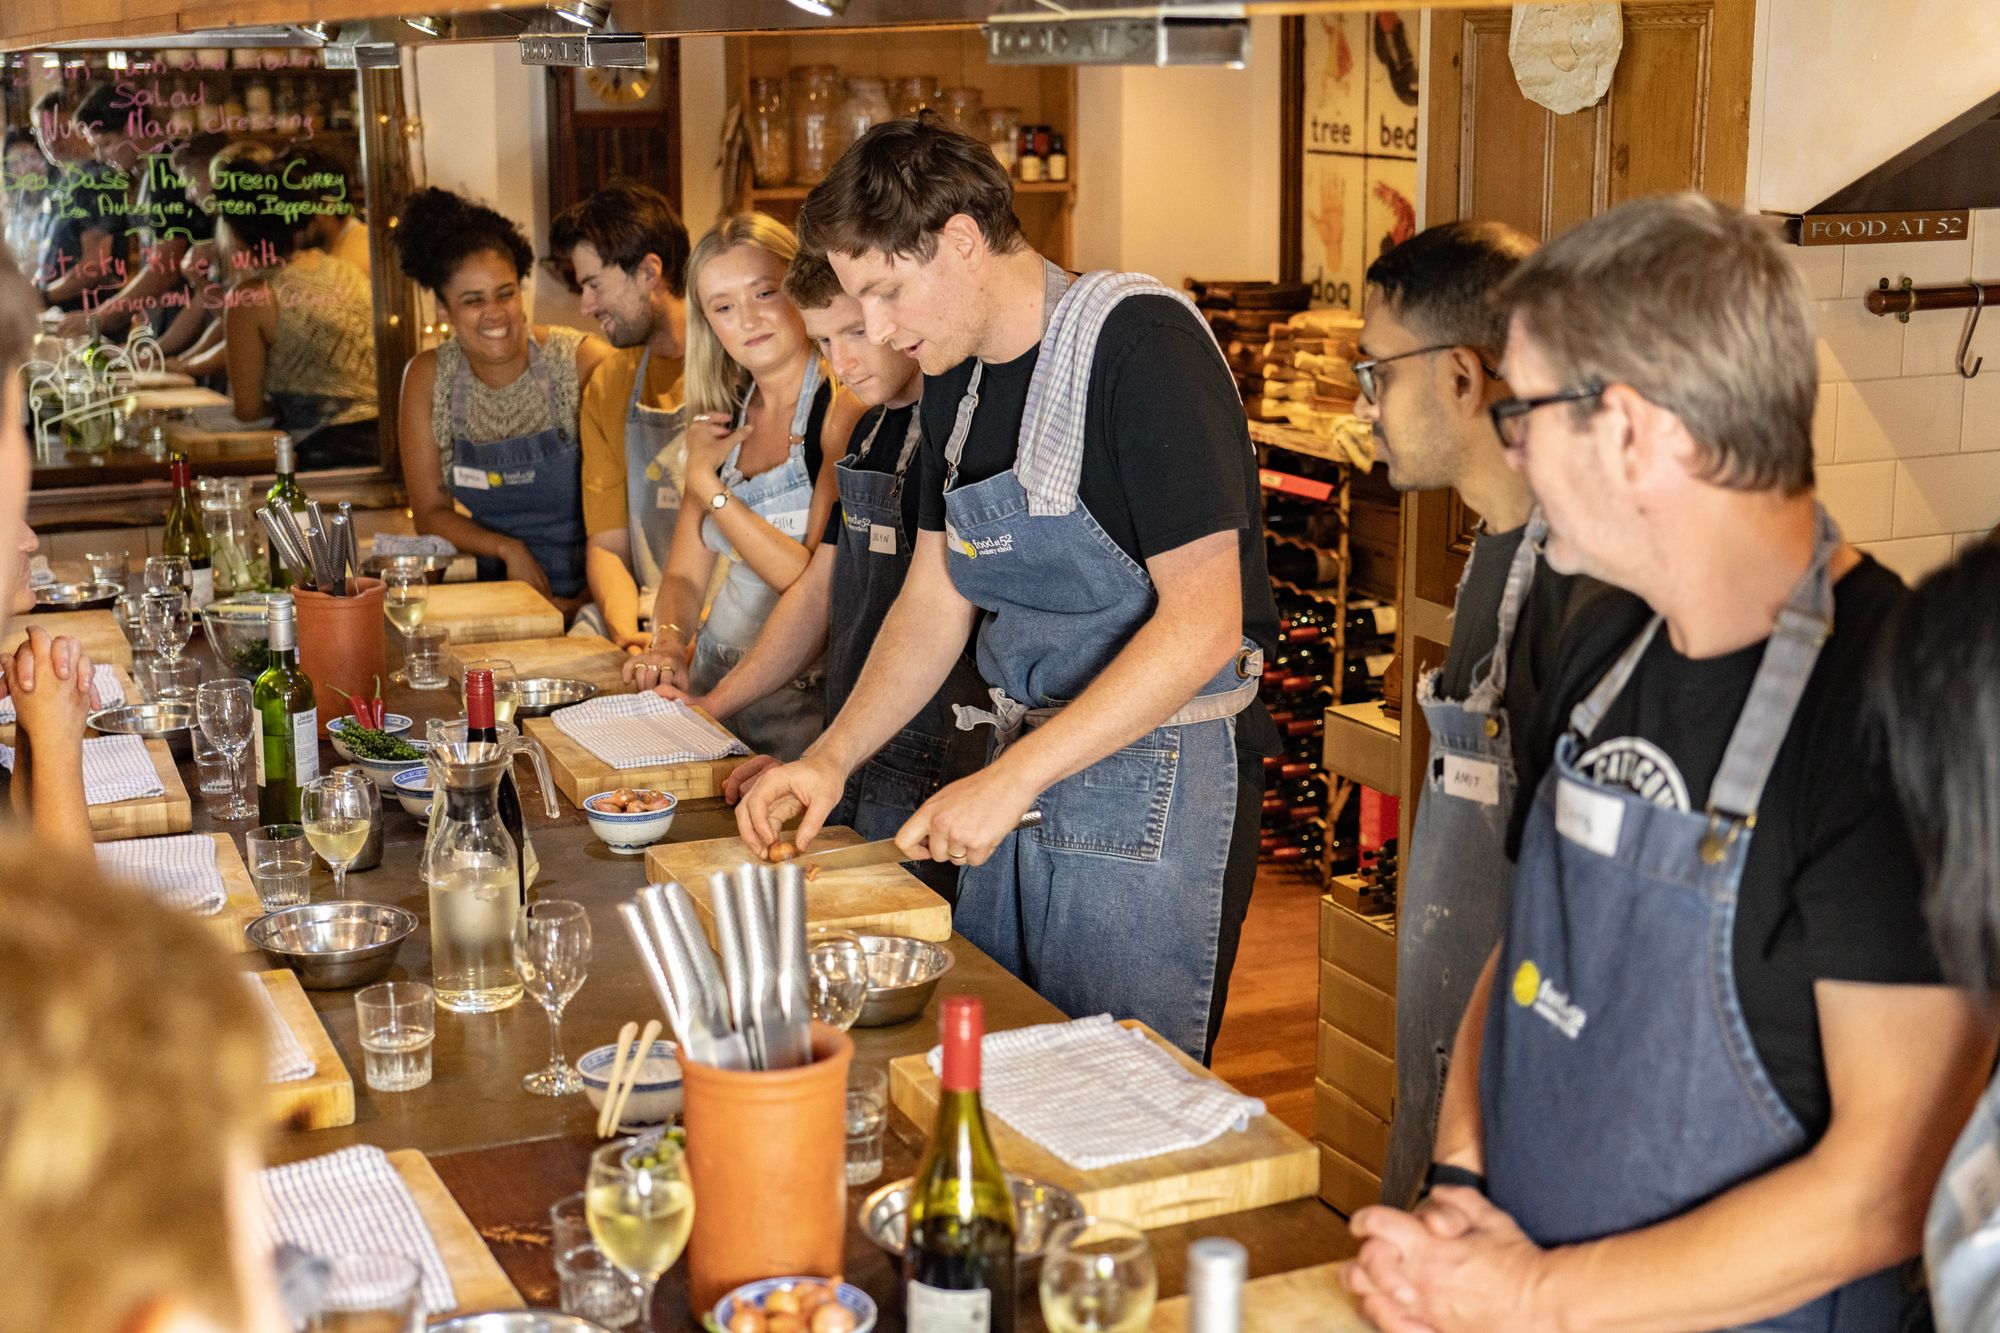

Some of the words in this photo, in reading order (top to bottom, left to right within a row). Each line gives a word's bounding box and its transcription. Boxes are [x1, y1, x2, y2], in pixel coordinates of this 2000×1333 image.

[521, 41, 552, 60] FOOD
[1311, 117, 1352, 144] tree
[1380, 114, 1418, 151] bed
[209, 155, 279, 192] Green
[202, 193, 257, 216] Green
[1811, 220, 1888, 239] FOOD
[1892, 217, 1930, 236] AT
[1935, 217, 1963, 235] 52
[161, 284, 191, 309] and
[972, 536, 996, 550] food
[999, 533, 1013, 547] 52
[1453, 770, 1481, 788] AMIT
